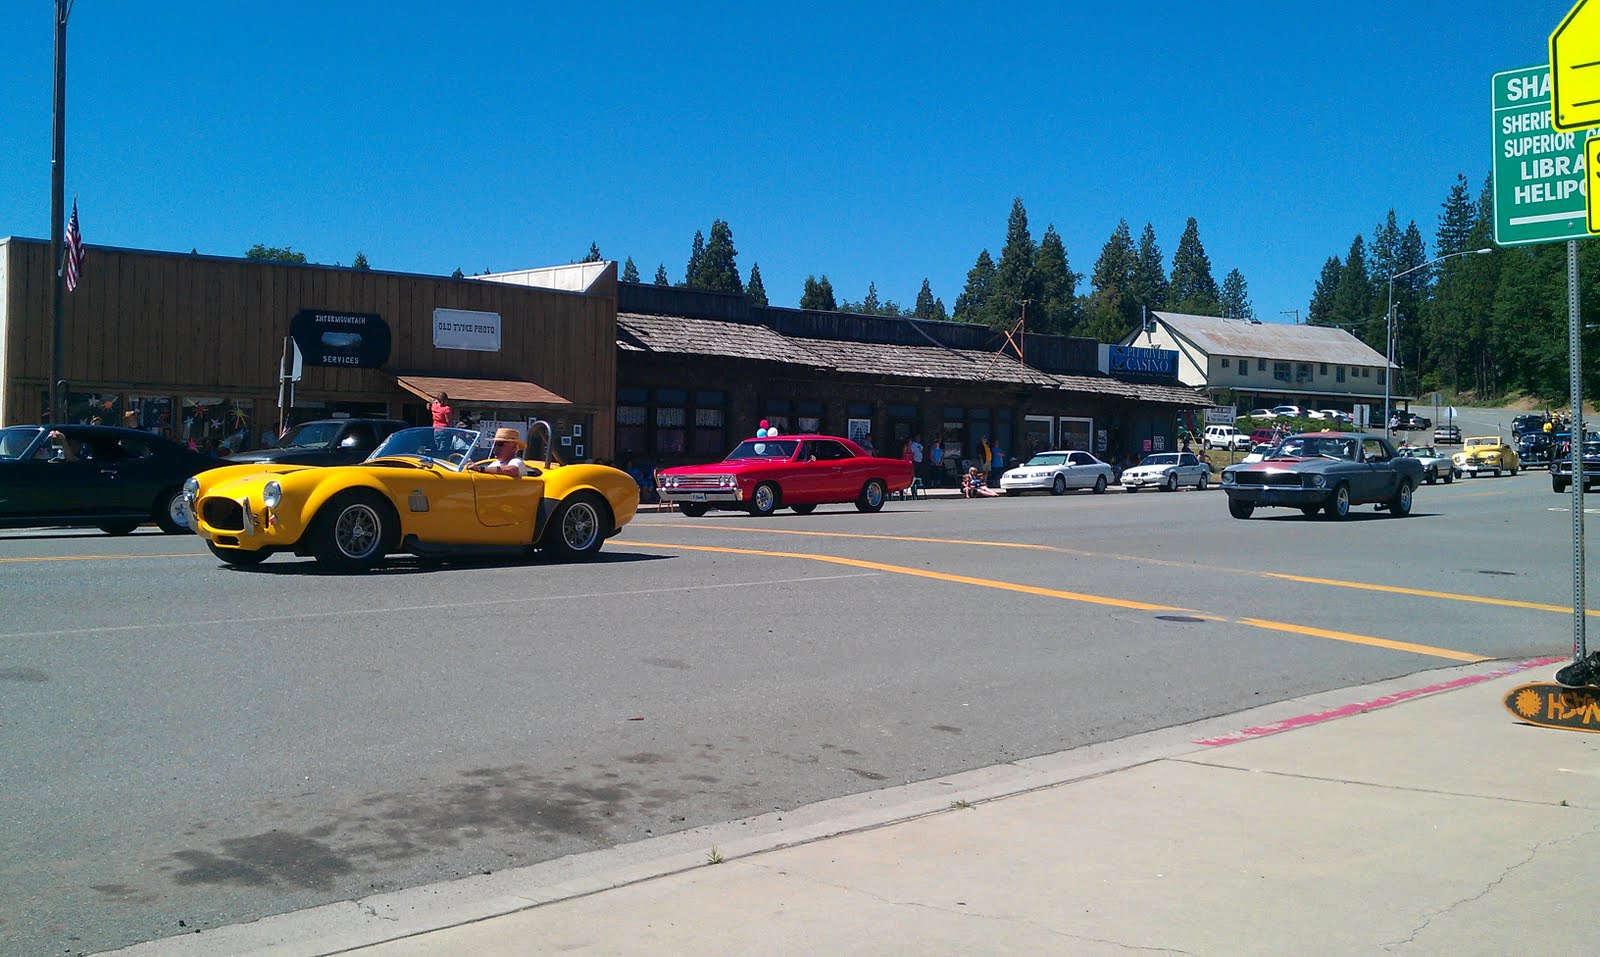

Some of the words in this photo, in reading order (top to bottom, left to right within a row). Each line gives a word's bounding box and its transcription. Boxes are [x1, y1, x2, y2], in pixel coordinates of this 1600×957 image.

[1507, 73, 1550, 101] SHA
[1504, 131, 1575, 158] SUPERIOR
[1521, 154, 1584, 180] LIBRA
[315, 315, 366, 325] INTERMOUNTAIN
[438, 322, 452, 331] OLD
[453, 323, 473, 333] TYME
[474, 325, 495, 334] PHOTO
[322, 355, 360, 364] SERVICES
[1126, 358, 1169, 372] CASINO
